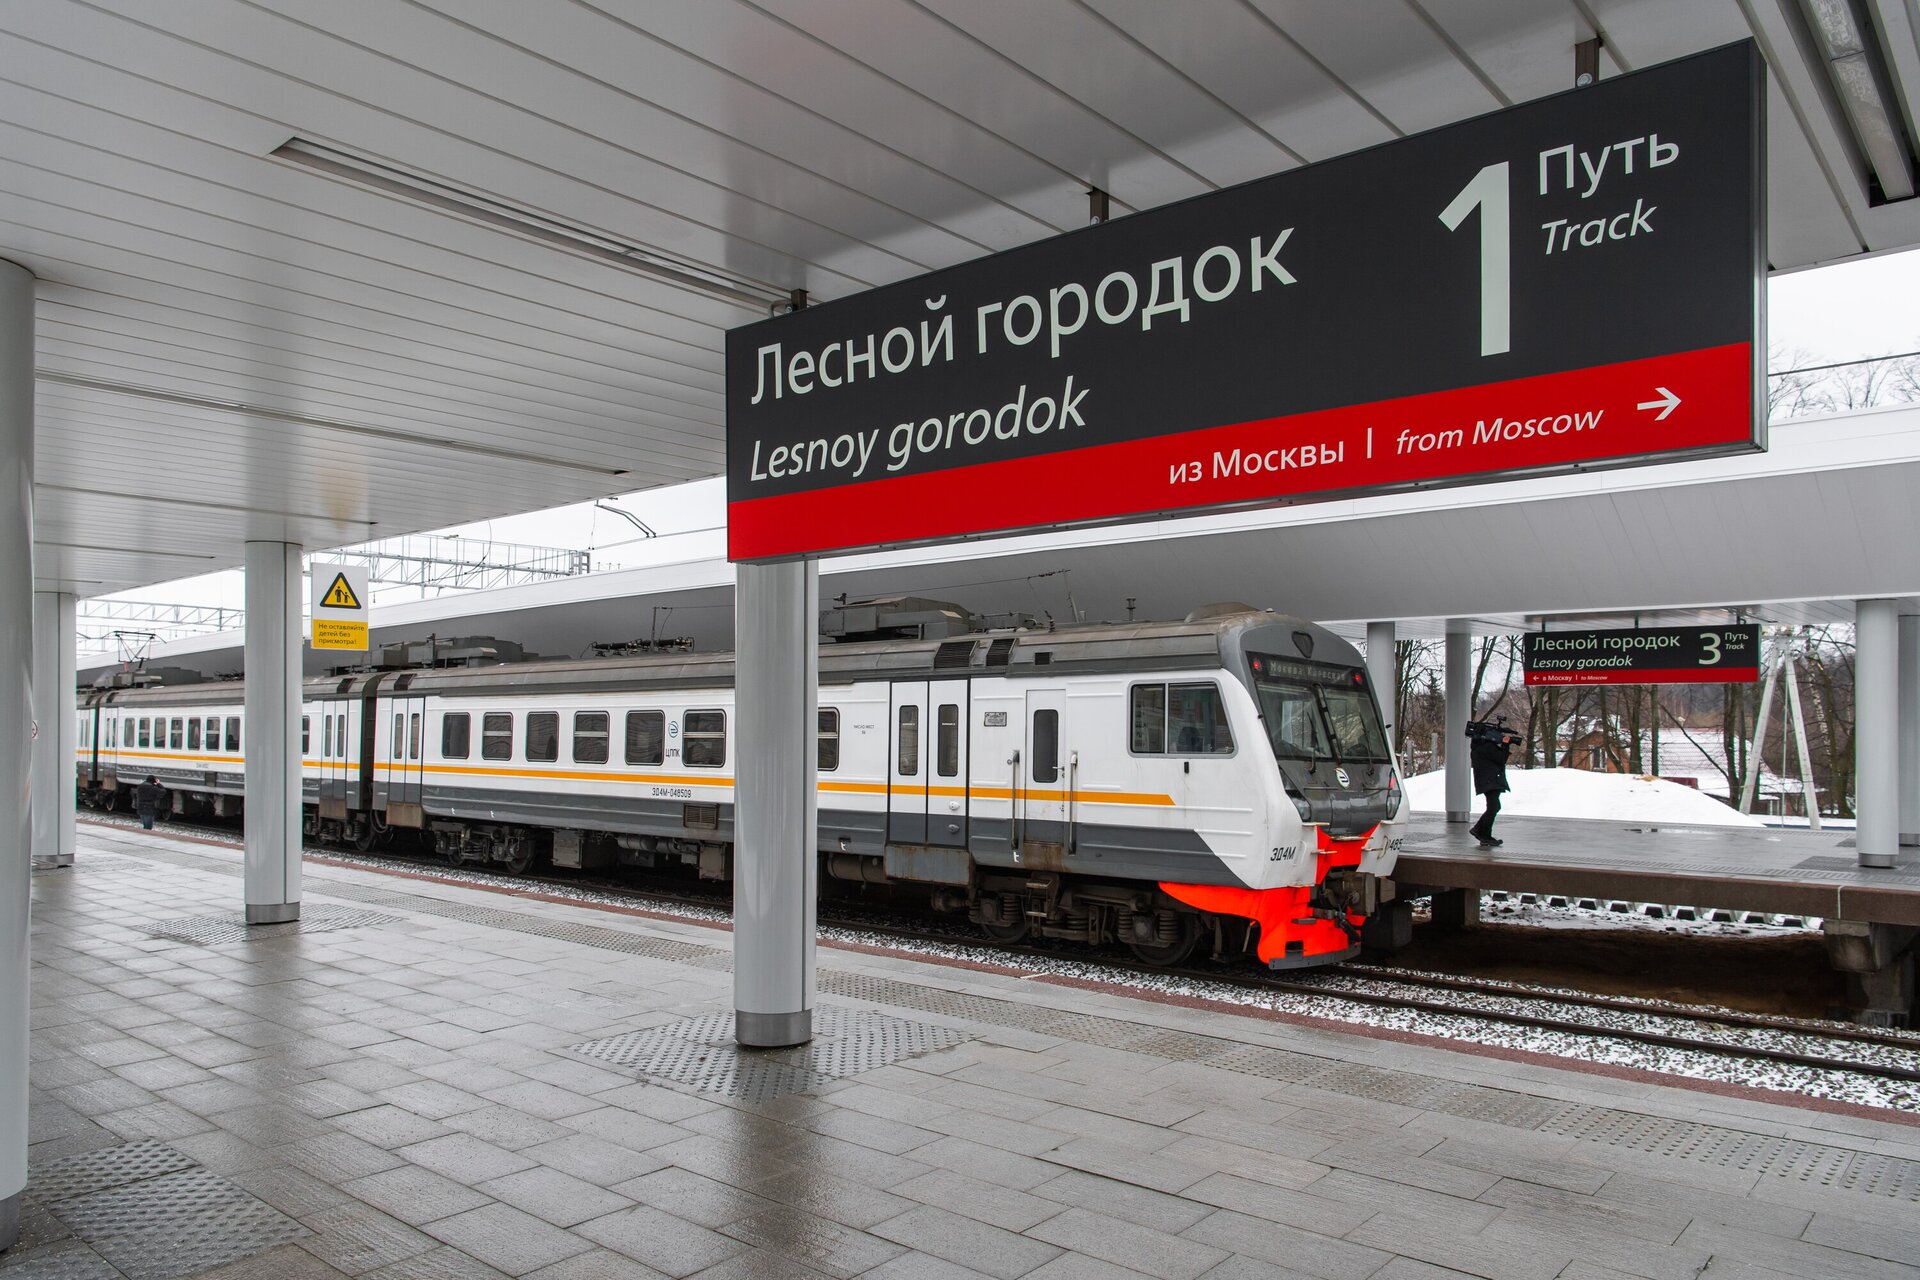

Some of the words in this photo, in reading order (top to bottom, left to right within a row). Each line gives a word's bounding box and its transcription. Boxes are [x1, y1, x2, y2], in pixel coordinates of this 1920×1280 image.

[1538, 133, 1680, 199] Путь
[1541, 198, 1658, 255] Track
[1438, 160, 1511, 357] 1
[750, 294, 955, 406] Лесной
[977, 227, 1298, 360] городок
[750, 428, 880, 482] Lesnoy
[886, 375, 1091, 471] gorodok
[1396, 428, 1464, 456] from
[1472, 409, 1605, 445] Moscow
[1168, 461, 1203, 485] из
[1213, 440, 1345, 479] Москвы
[1533, 634, 1598, 651] Лесной
[1603, 635, 1681, 652] городок
[1698, 632, 1722, 665] 3
[1724, 632, 1749, 643] Путь
[1532, 657, 1575, 669] Lesnoy
[1576, 655, 1633, 670] gorodok
